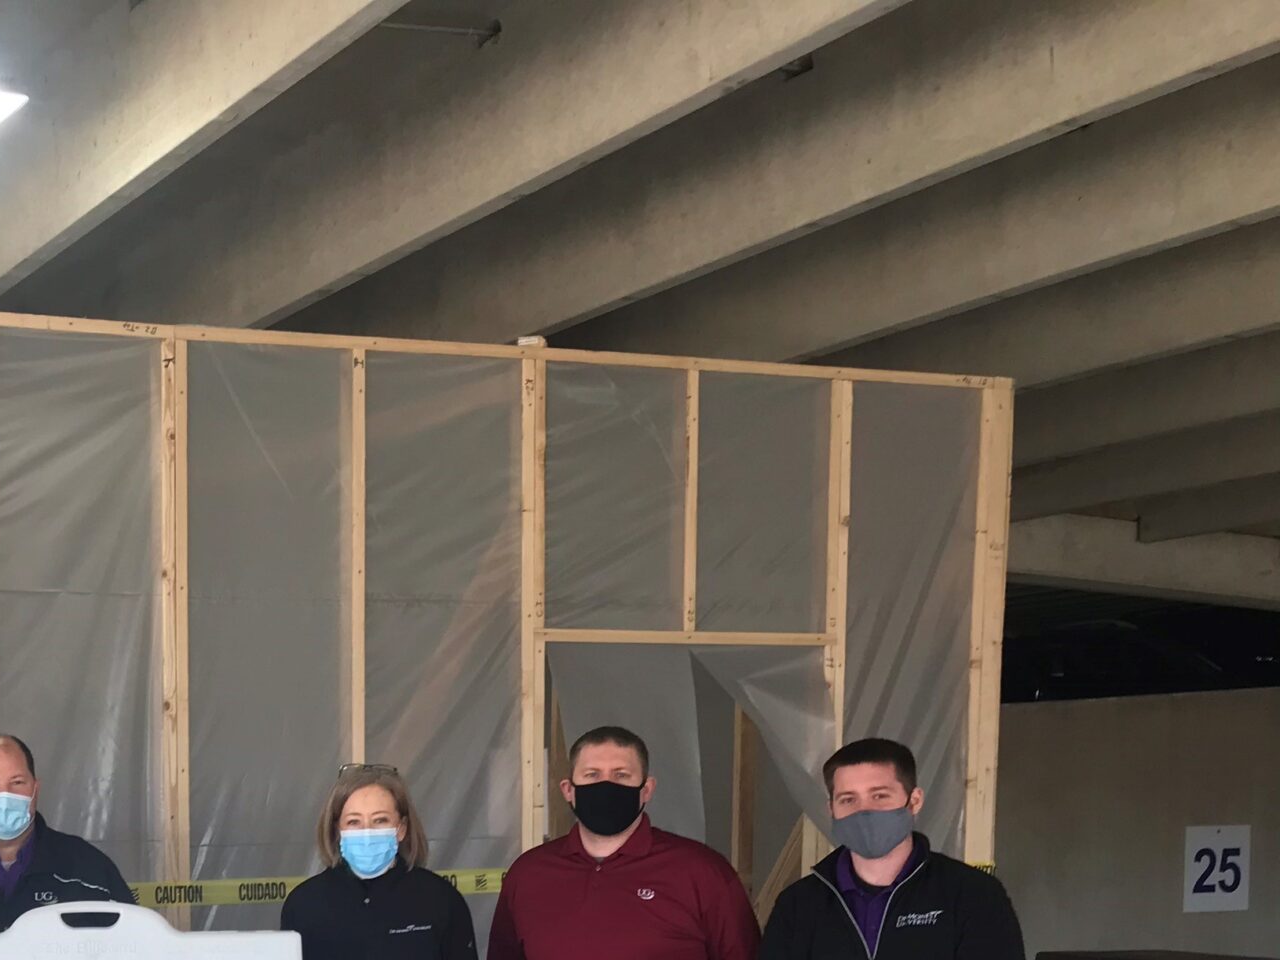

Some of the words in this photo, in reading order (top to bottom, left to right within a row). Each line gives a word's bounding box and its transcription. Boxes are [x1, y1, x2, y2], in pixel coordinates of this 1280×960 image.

[1192, 847, 1242, 894] 25
[155, 885, 203, 904] CAUTION
[238, 882, 287, 901] CUIDADO
